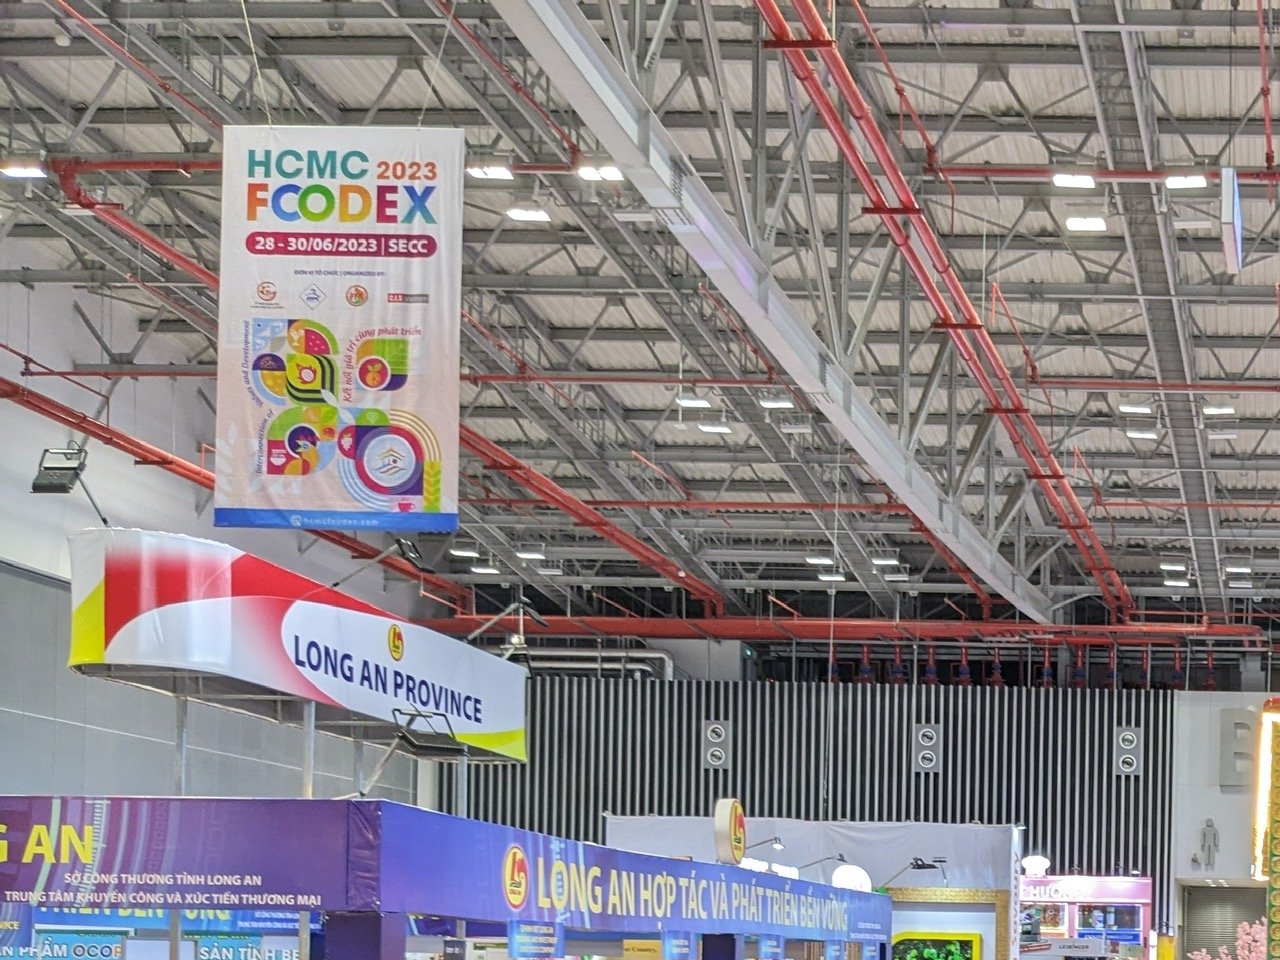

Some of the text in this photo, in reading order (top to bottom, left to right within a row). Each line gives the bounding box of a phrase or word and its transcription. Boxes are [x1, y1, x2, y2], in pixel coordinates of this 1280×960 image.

[248, 149, 437, 180] HCMC 2023
[255, 236, 274, 250] 28
[287, 238, 377, 252] 30/06/2023
[388, 239, 428, 253] SECC
[241, 320, 250, 368] Development
[294, 635, 482, 724] LONG AN PROVINCE
[22, 824, 93, 864] AN
[82, 872, 118, 884] CÔNG
[120, 873, 174, 885] THƯƠNG
[207, 875, 242, 886] LONG
[243, 875, 262, 886] AN
[538, 857, 602, 914] LONG
[608, 869, 635, 916] AN
[639, 870, 676, 930] HỢP
[679, 870, 708, 920] TÁC
[710, 872, 729, 920] VÀ
[732, 878, 764, 922] PHÁT
[5, 891, 46, 902] TRUNG
[48, 890, 74, 902] TÂM
[129, 891, 164, 904] CÔNG
[166, 892, 182, 904] VÀ
[242, 894, 294, 906] THƯƠNG
[297, 895, 322, 908] MẠI
[200, 942, 234, 960] SẢN
